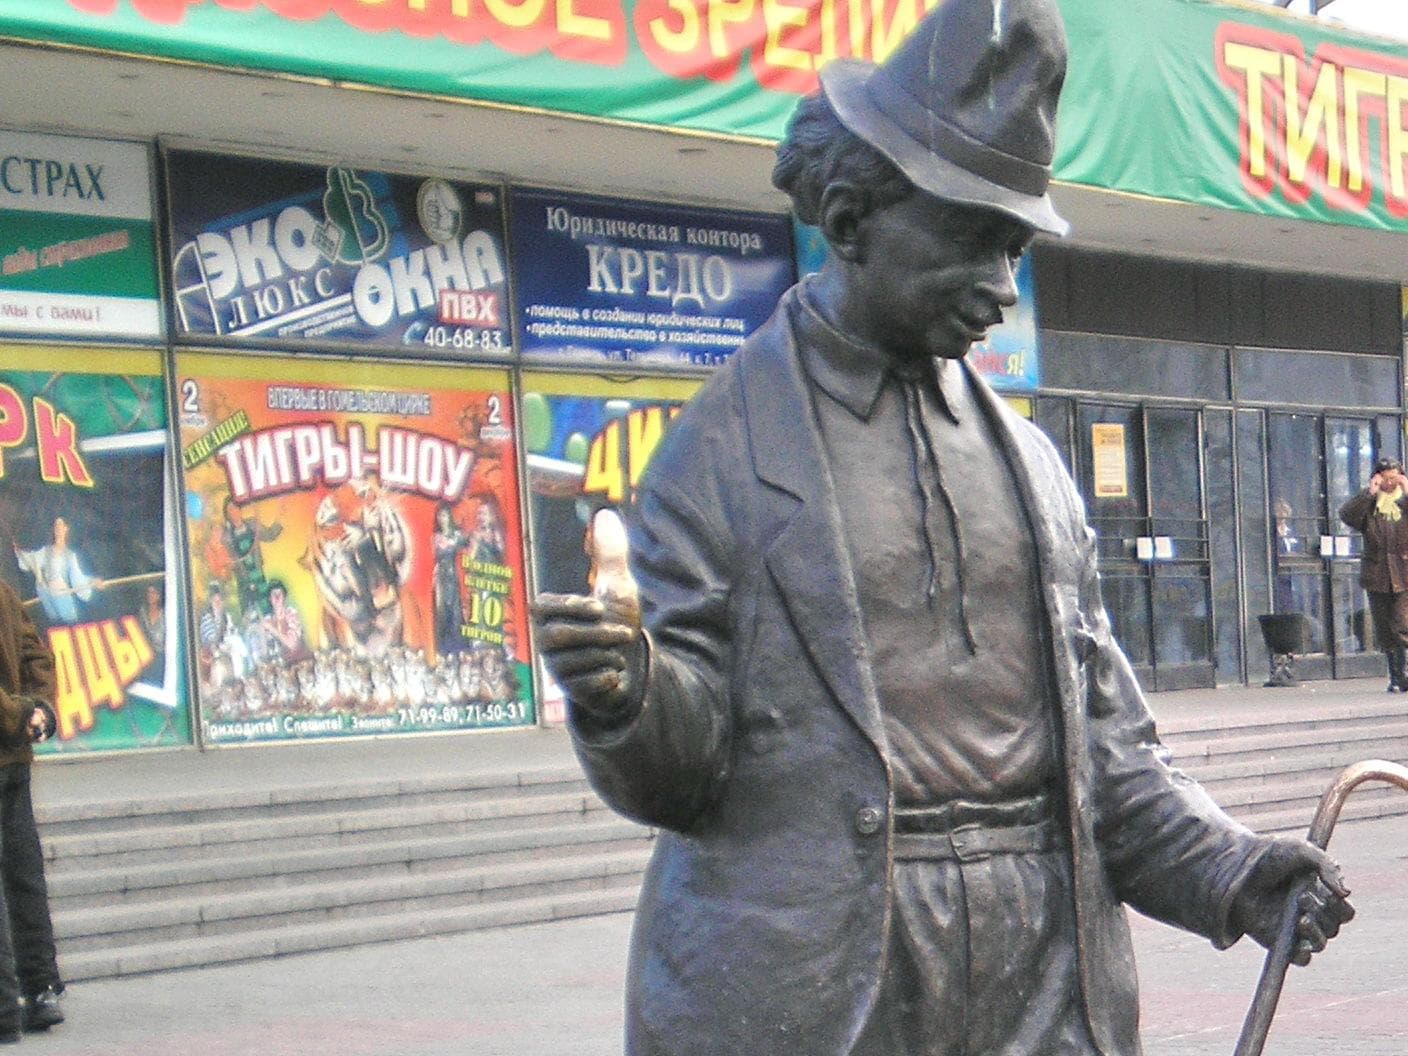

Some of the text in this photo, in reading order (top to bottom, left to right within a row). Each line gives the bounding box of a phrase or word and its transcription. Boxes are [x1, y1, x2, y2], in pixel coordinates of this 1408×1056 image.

[1, 156, 105, 201] СТРАХ
[196, 206, 321, 300] ЭКО
[546, 206, 763, 255] Юридическая контора
[228, 268, 335, 329] ЛЮКС
[353, 229, 504, 327] ОКНА
[585, 244, 733, 309] КРЕДО
[438, 291, 497, 322] ПВХ
[424, 327, 503, 351] 40-68-83
[183, 381, 199, 412] 2
[487, 395, 500, 424] 2
[217, 422, 475, 500] ТИГРЫ-ШОУ
[469, 591, 503, 629] 10
